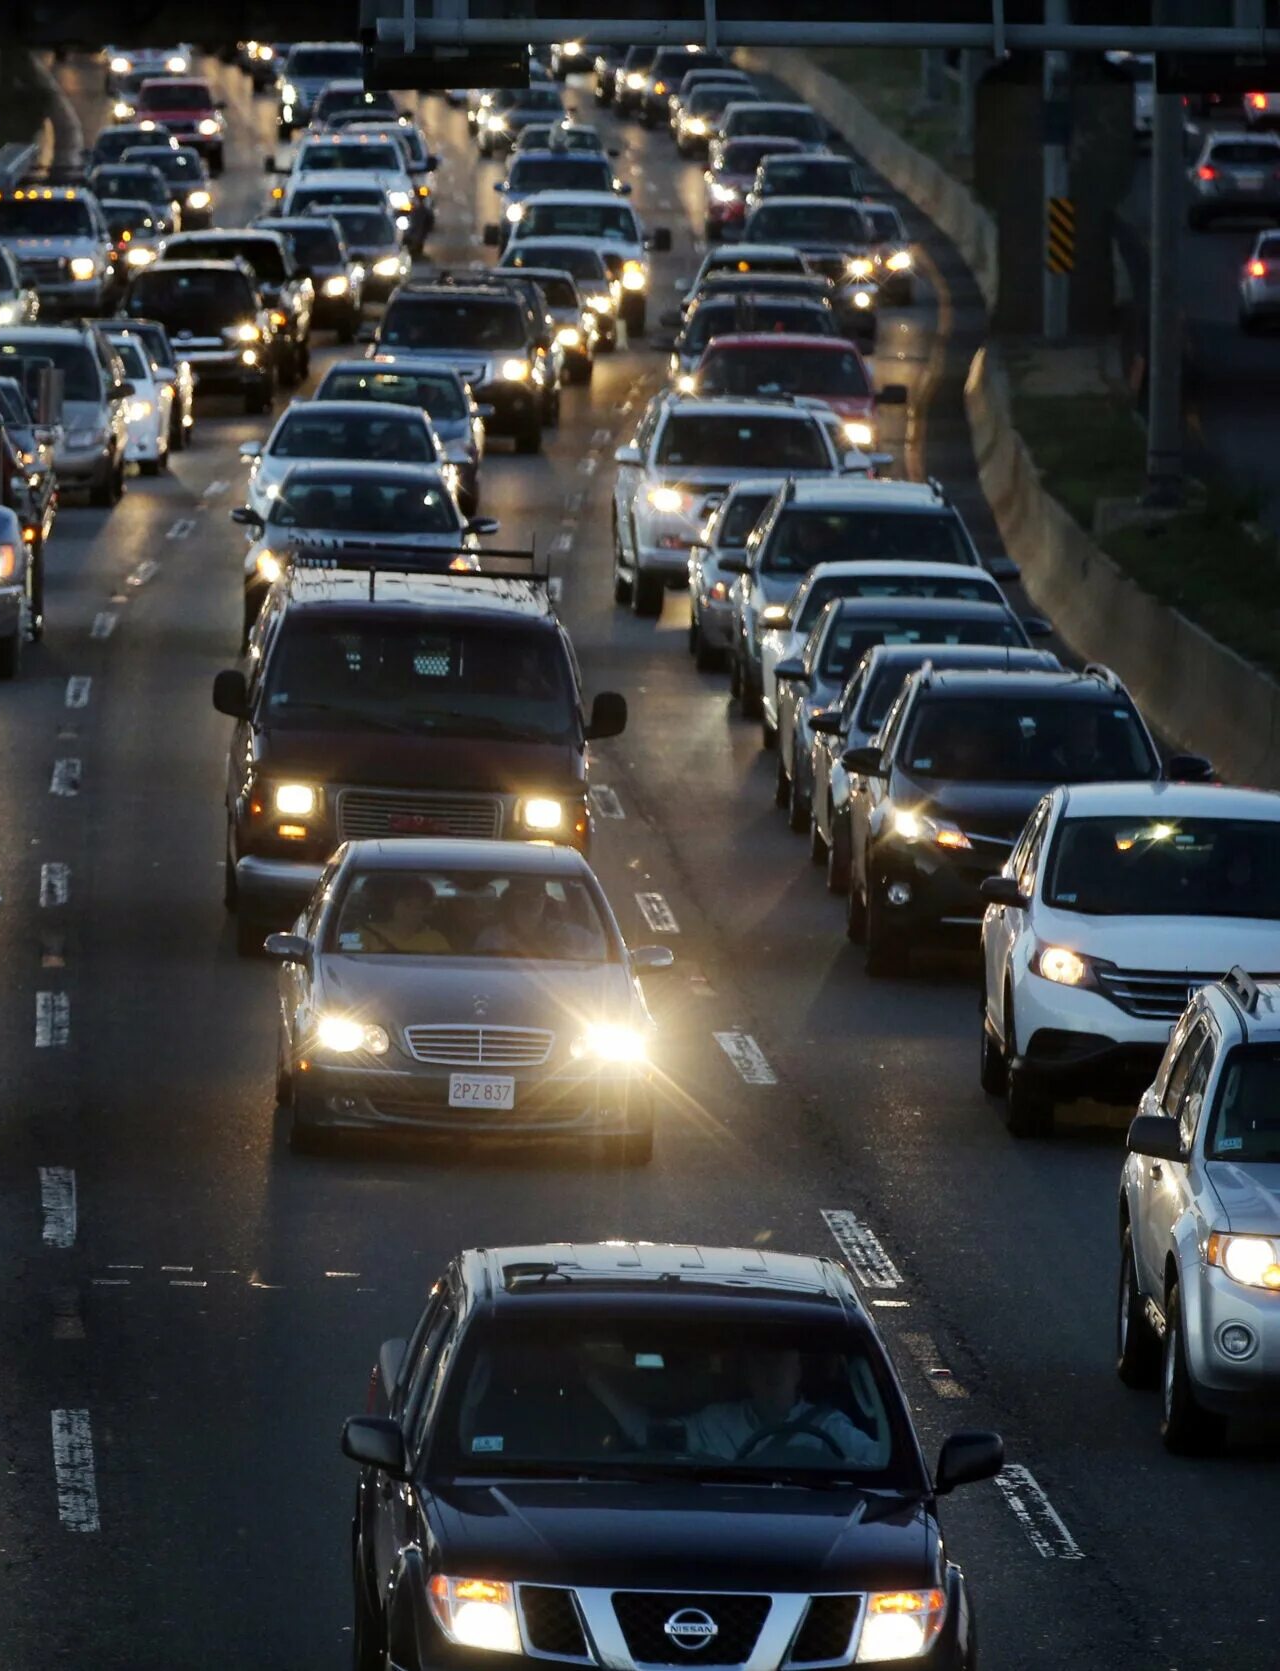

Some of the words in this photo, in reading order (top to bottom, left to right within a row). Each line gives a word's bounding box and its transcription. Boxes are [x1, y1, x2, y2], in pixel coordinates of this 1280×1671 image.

[453, 1082, 480, 1100] 2PZ
[484, 1084, 511, 1101] 837
[670, 1624, 713, 1634] NISSAN
